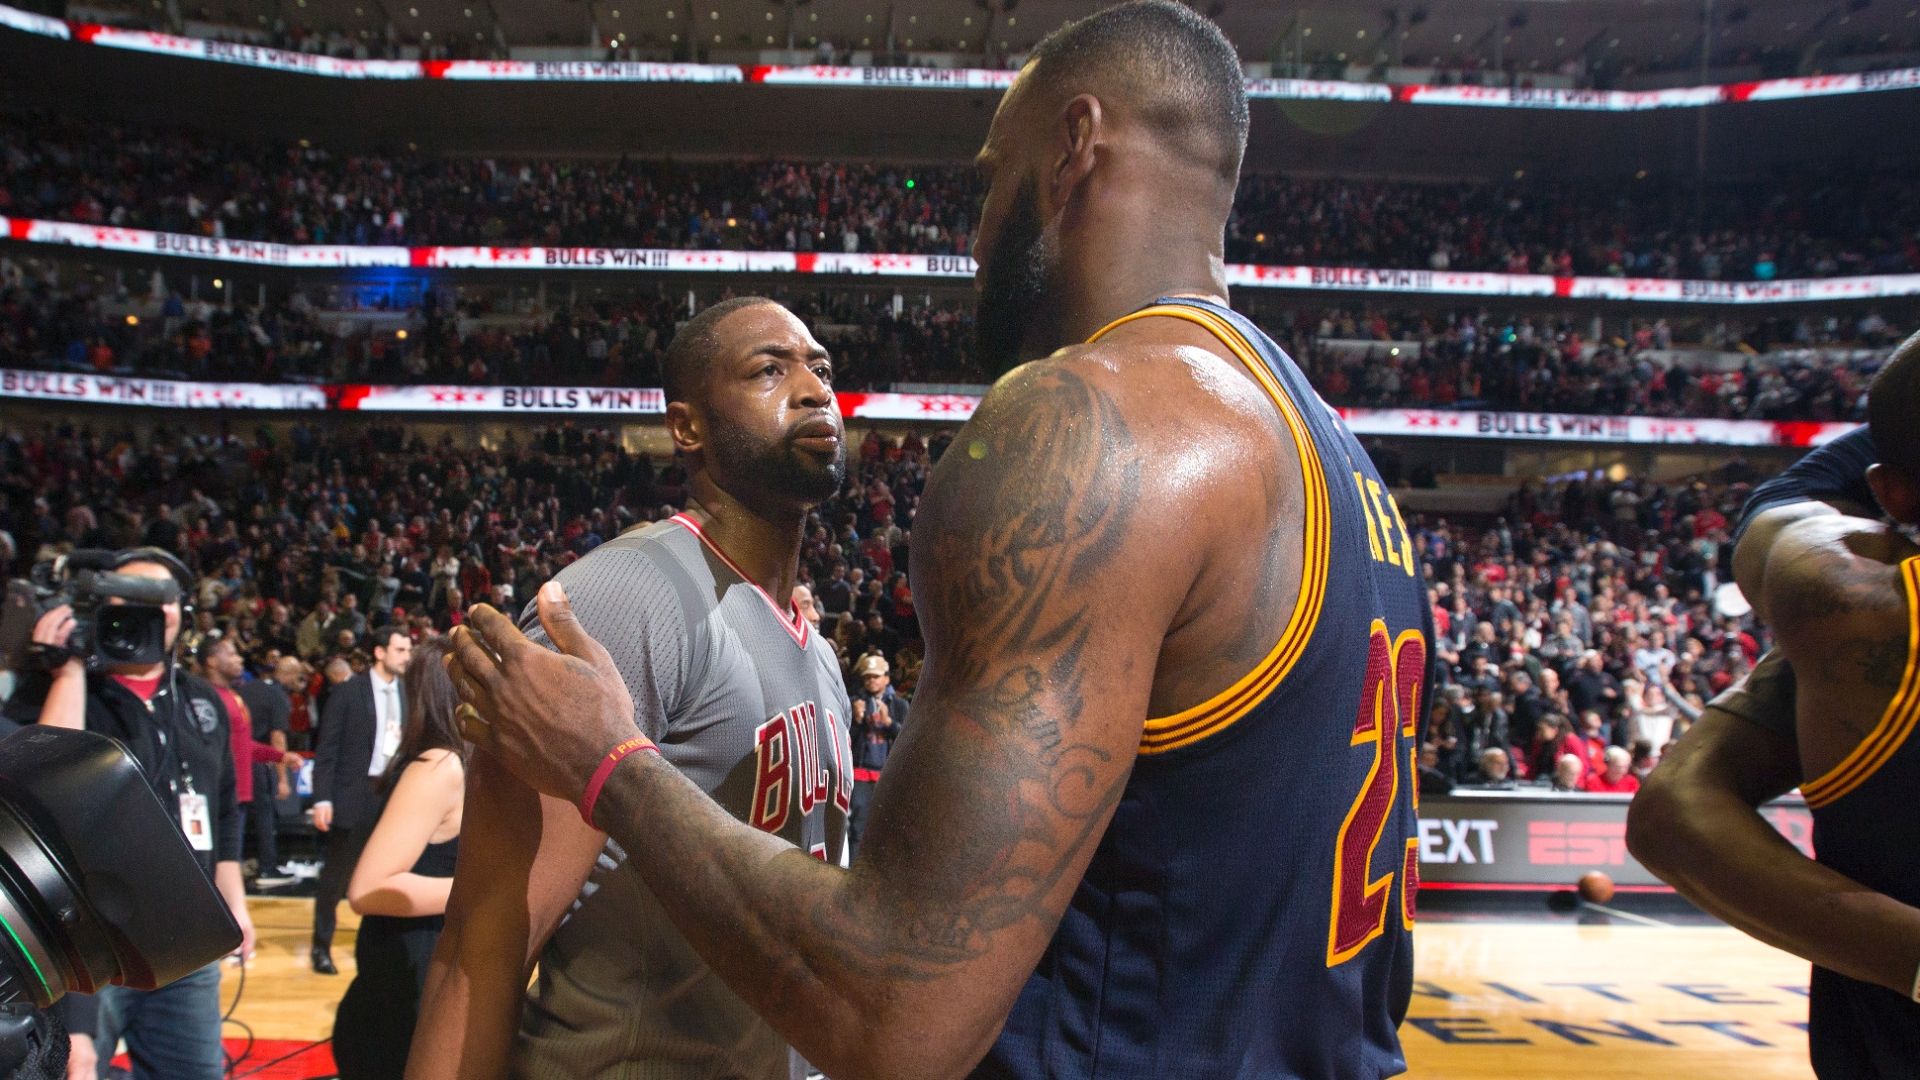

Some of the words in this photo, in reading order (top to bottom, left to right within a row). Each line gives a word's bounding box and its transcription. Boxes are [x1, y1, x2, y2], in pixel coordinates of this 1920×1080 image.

[155, 233, 220, 255] BULLS
[545, 249, 605, 265] BULLS
[1311, 269, 1370, 286] BULLS
[2, 372, 86, 396] BULLS
[503, 390, 579, 409] BULLS
[1479, 413, 1551, 434] BULLS
[749, 700, 854, 834] BULL
[1418, 818, 1499, 864] EXT
